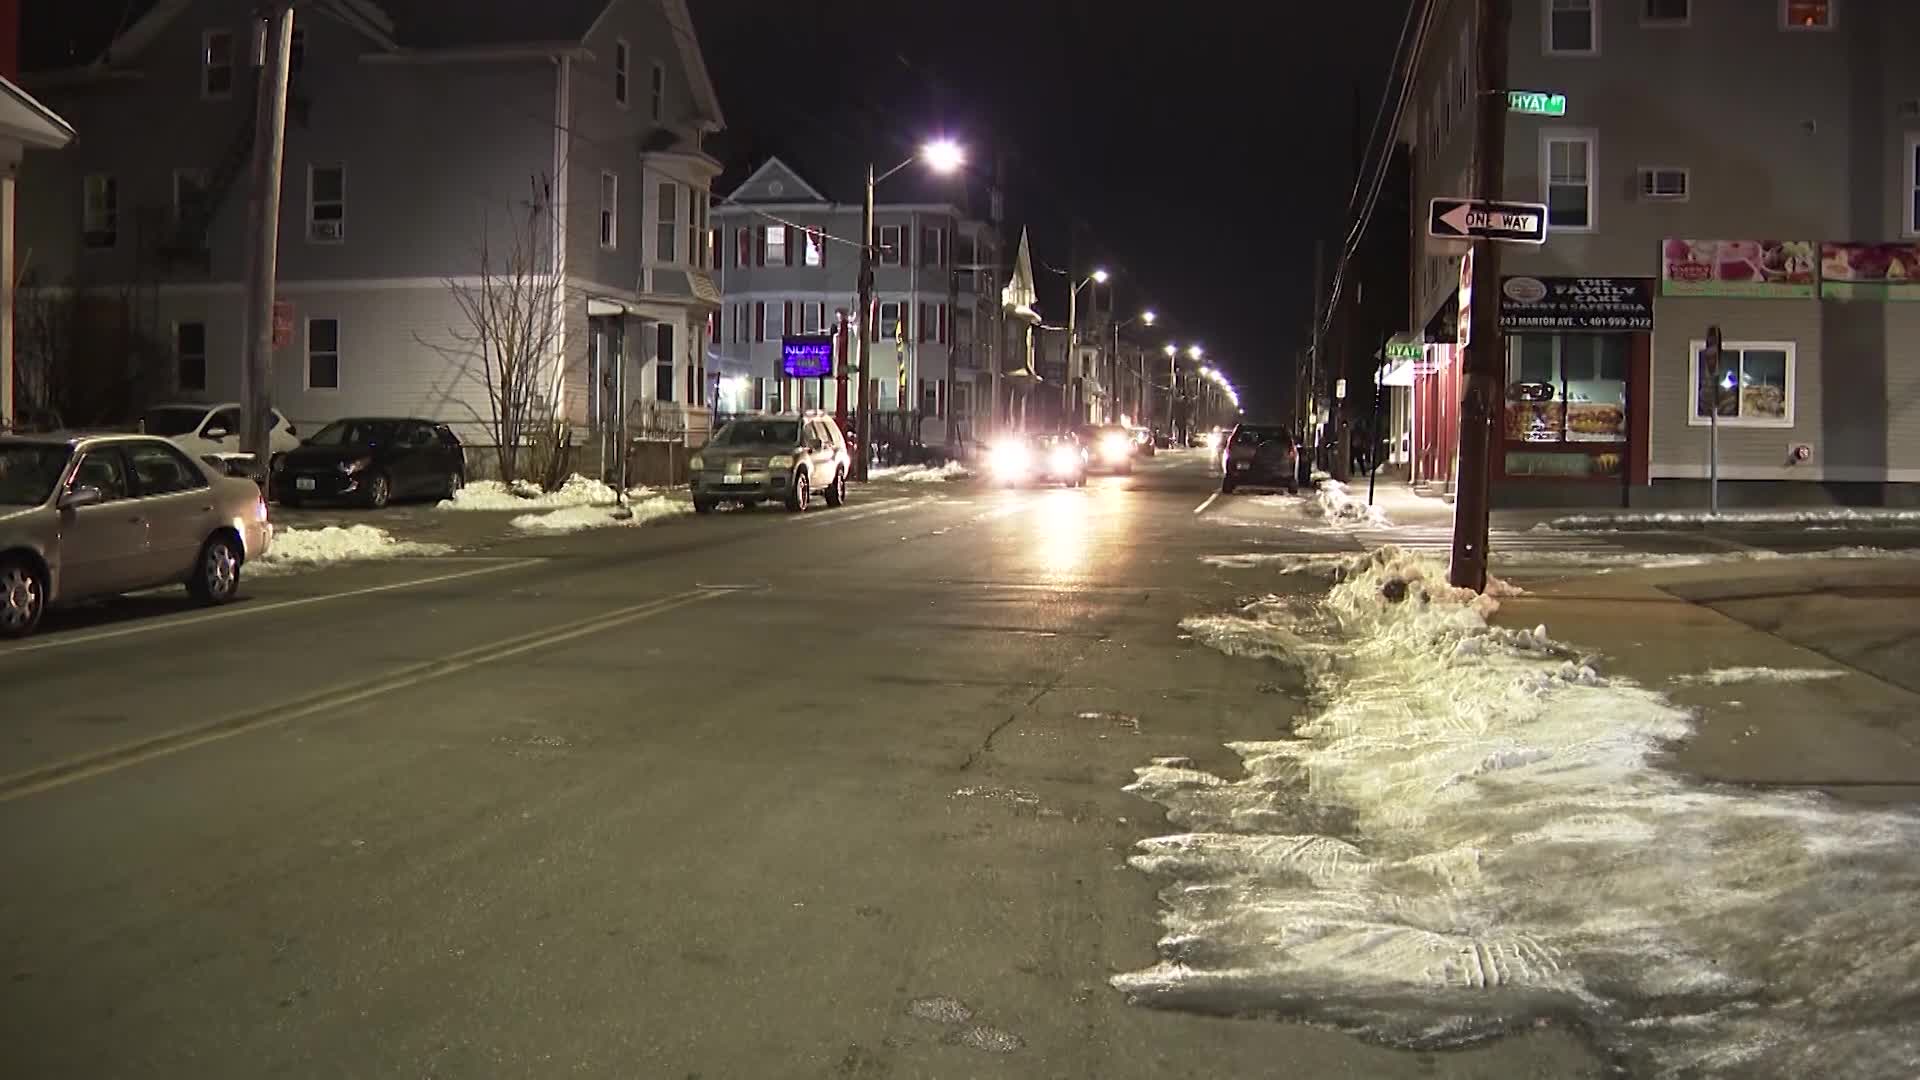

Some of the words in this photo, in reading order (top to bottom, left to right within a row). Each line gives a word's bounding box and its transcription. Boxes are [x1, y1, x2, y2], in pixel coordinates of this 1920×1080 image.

[1511, 94, 1548, 112] HYAT
[1465, 213, 1491, 228] ONE
[1502, 215, 1529, 230] WAY
[1577, 279, 1612, 287] THE
[1553, 286, 1636, 295] FAMILY
[1518, 316, 1556, 327] MANTON
